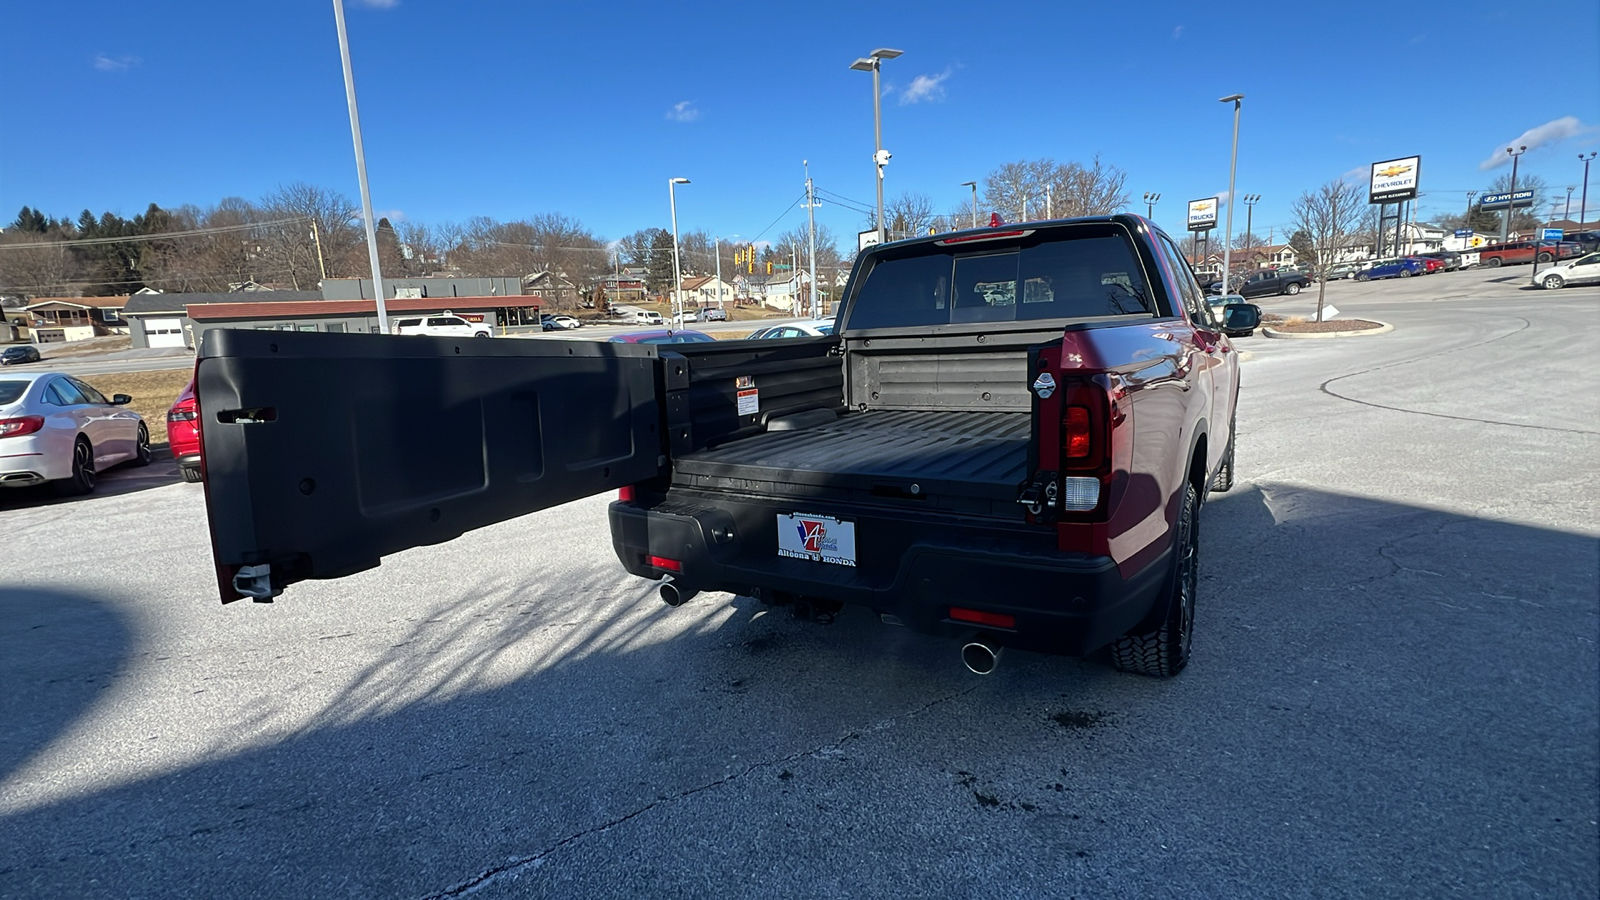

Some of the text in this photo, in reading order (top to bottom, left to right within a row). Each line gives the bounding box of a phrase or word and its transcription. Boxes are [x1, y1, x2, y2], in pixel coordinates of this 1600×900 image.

[1374, 179, 1412, 189] CHEVROLET
[1190, 213, 1214, 221] TRUCKS
[793, 512, 836, 520] altoonahonda.com
[778, 549, 810, 559] Altoona
[823, 556, 856, 567] HONDA
